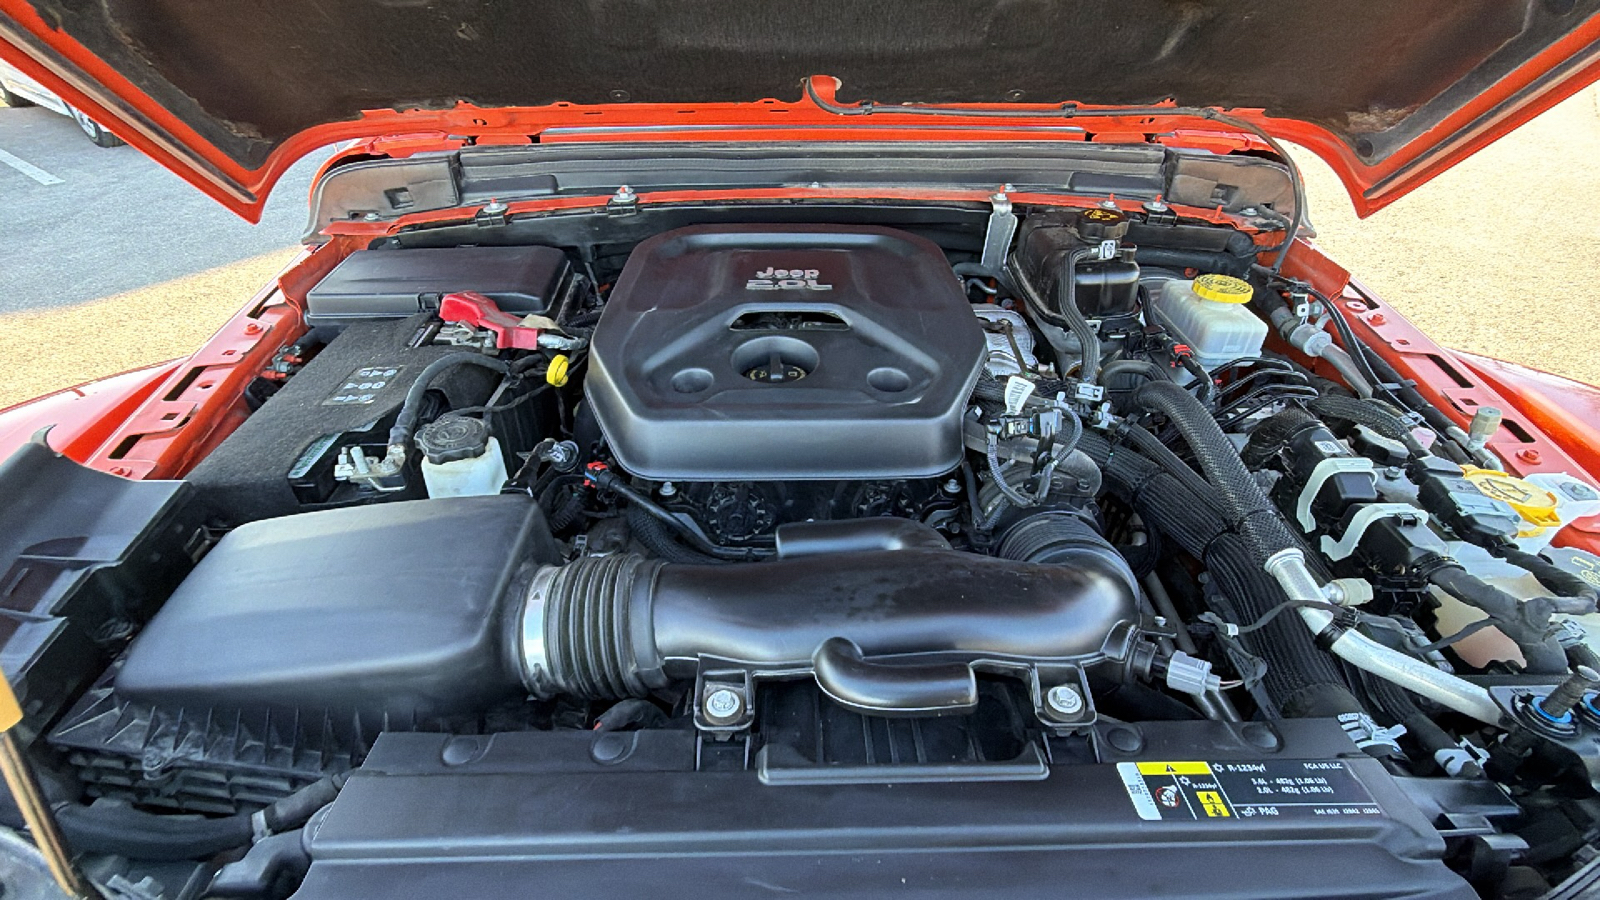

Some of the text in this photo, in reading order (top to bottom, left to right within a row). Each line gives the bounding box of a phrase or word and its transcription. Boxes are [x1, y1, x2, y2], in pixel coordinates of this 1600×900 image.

[756, 267, 820, 279] Jeep
[745, 279, 833, 290] 2.0L
[1226, 763, 1267, 773] R-1234yf
[1258, 806, 1280, 816] PAG
